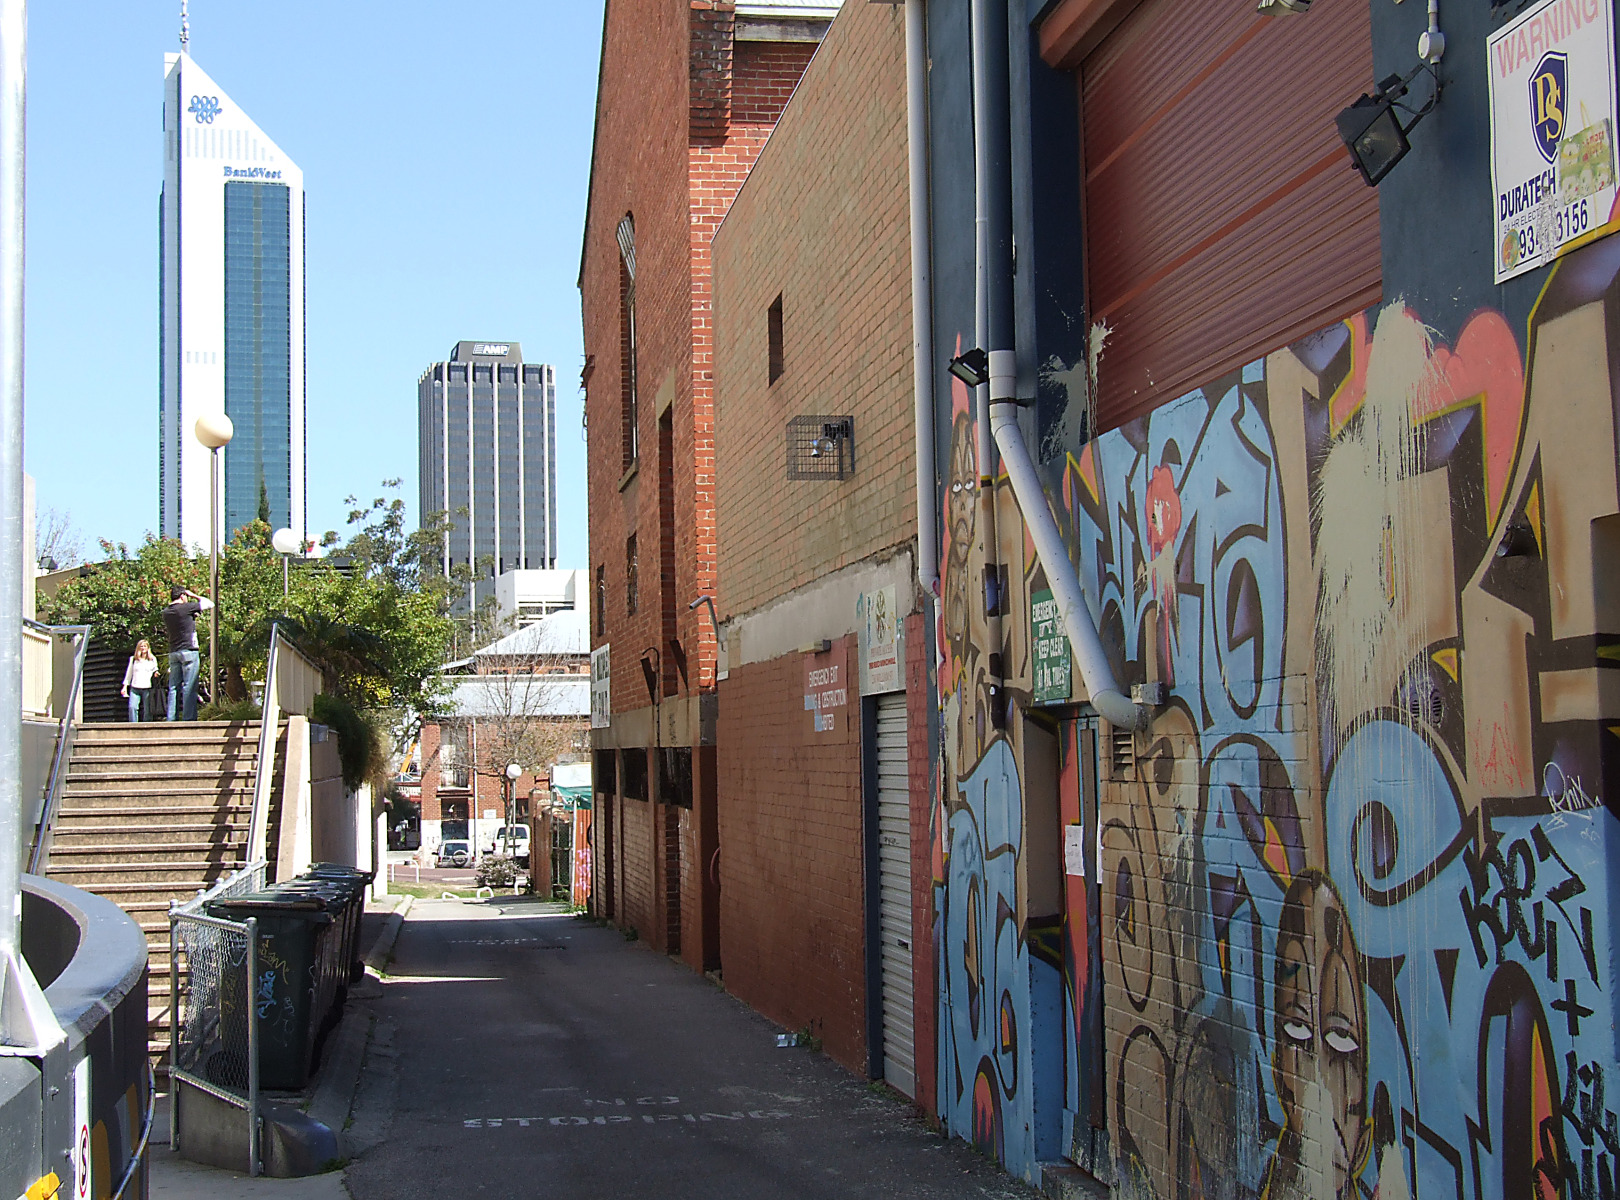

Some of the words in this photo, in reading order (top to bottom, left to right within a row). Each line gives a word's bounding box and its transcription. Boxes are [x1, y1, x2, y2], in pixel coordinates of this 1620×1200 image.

[1497, 0, 1599, 78] WARNING
[1500, 167, 1556, 221] DURATECH
[482, 344, 508, 355] AMP
